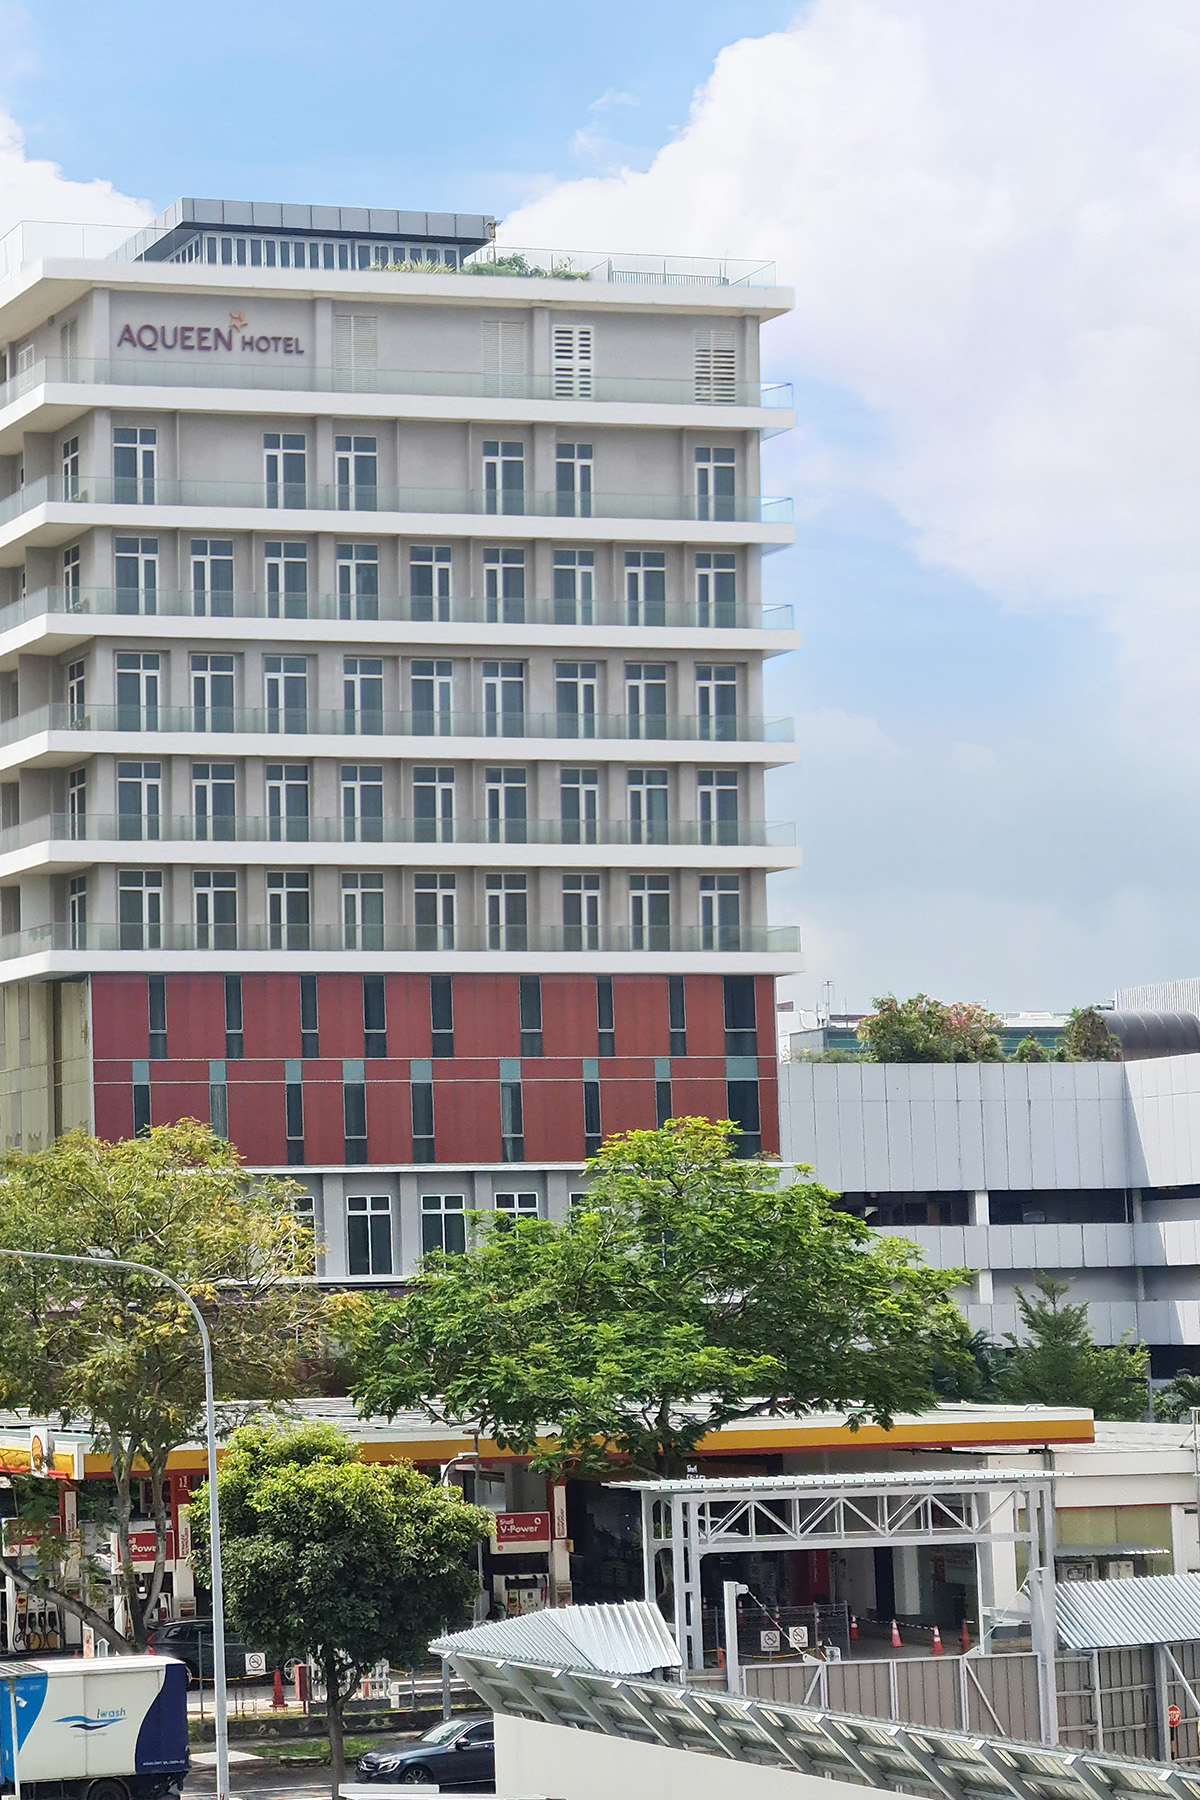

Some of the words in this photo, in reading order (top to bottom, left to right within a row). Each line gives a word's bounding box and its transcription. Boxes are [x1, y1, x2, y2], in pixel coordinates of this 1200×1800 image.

[117, 324, 233, 351] AQUEEN
[241, 335, 305, 354] HOTEL
[500, 1525, 538, 1534] V-Power
